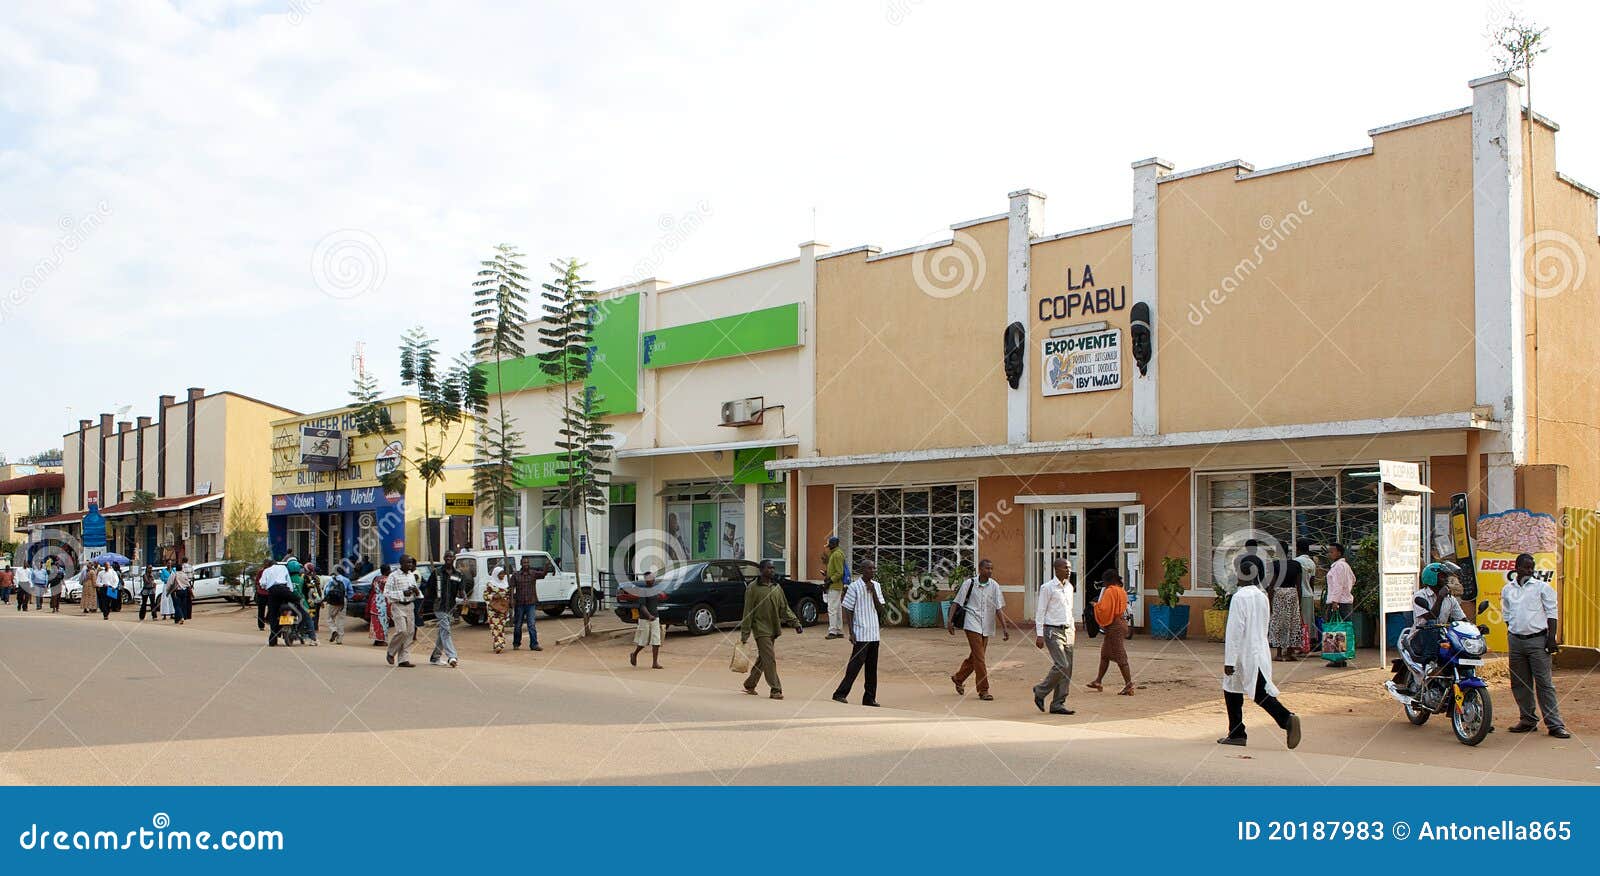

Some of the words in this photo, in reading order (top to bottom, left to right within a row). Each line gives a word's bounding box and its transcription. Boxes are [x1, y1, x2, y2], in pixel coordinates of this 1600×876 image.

[1067, 264, 1095, 291] LA
[1039, 285, 1126, 321] COPABU
[1045, 333, 1118, 355] EXPO-VENTE
[294, 493, 316, 509] Colour
[351, 487, 376, 505] World
